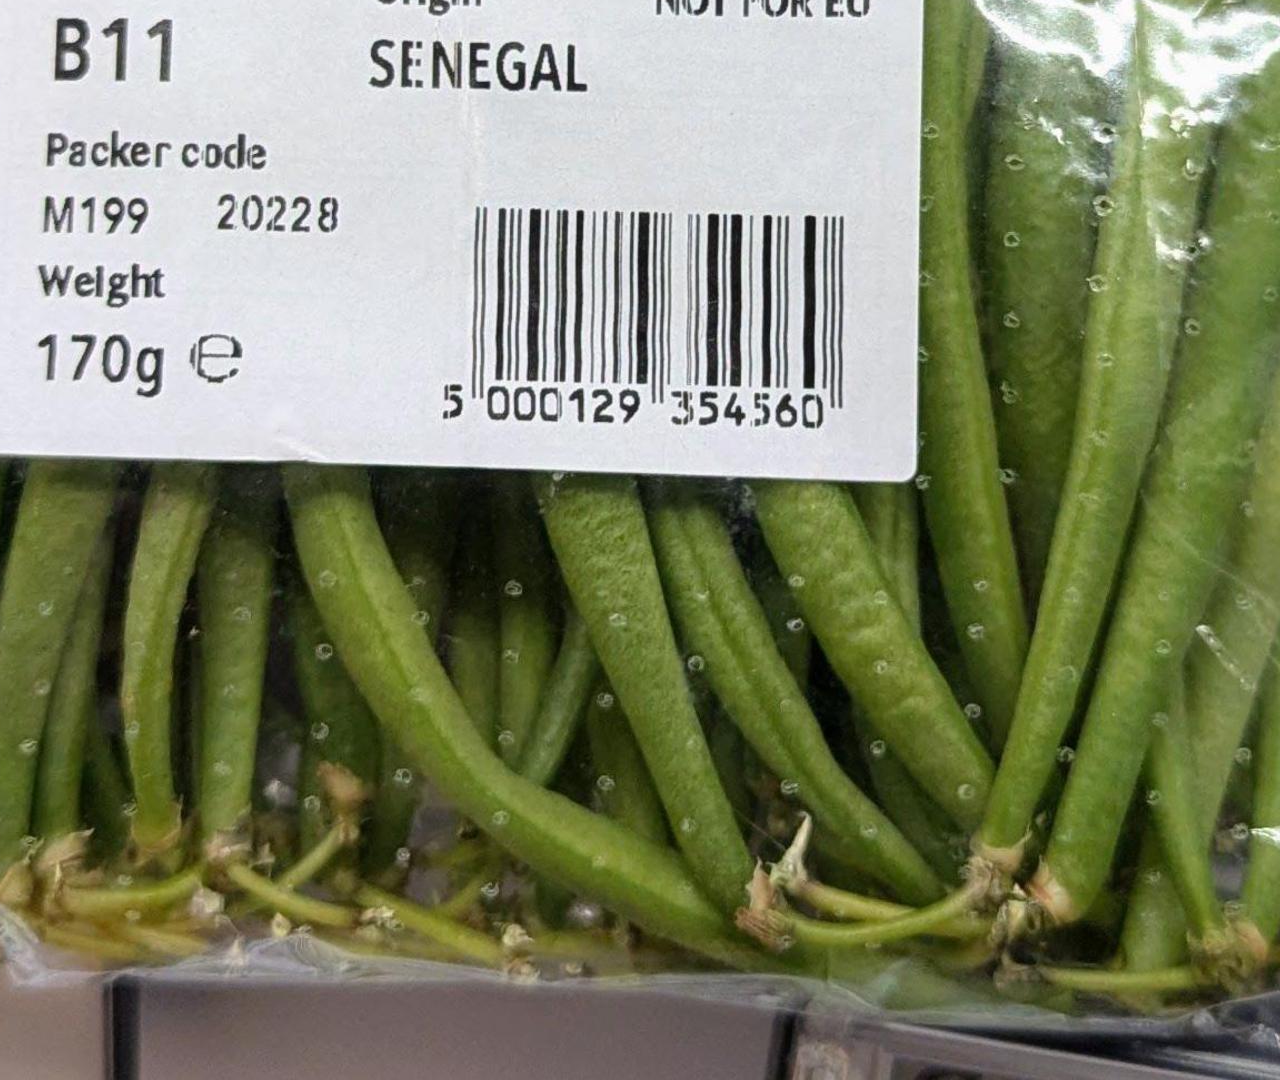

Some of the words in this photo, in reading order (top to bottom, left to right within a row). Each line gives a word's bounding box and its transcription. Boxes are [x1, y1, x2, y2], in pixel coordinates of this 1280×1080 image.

[54, 18, 173, 82] B11
[369, 40, 588, 92] SENEGAL
[46, 131, 170, 168] Packer
[181, 134, 267, 169] code
[43, 196, 149, 234] M199
[217, 194, 339, 233] 20228
[38, 264, 165, 308] Weight
[37, 334, 165, 398] 170g
[442, 384, 463, 419] 5
[487, 385, 642, 423] 000129
[671, 390, 824, 429] 354560
